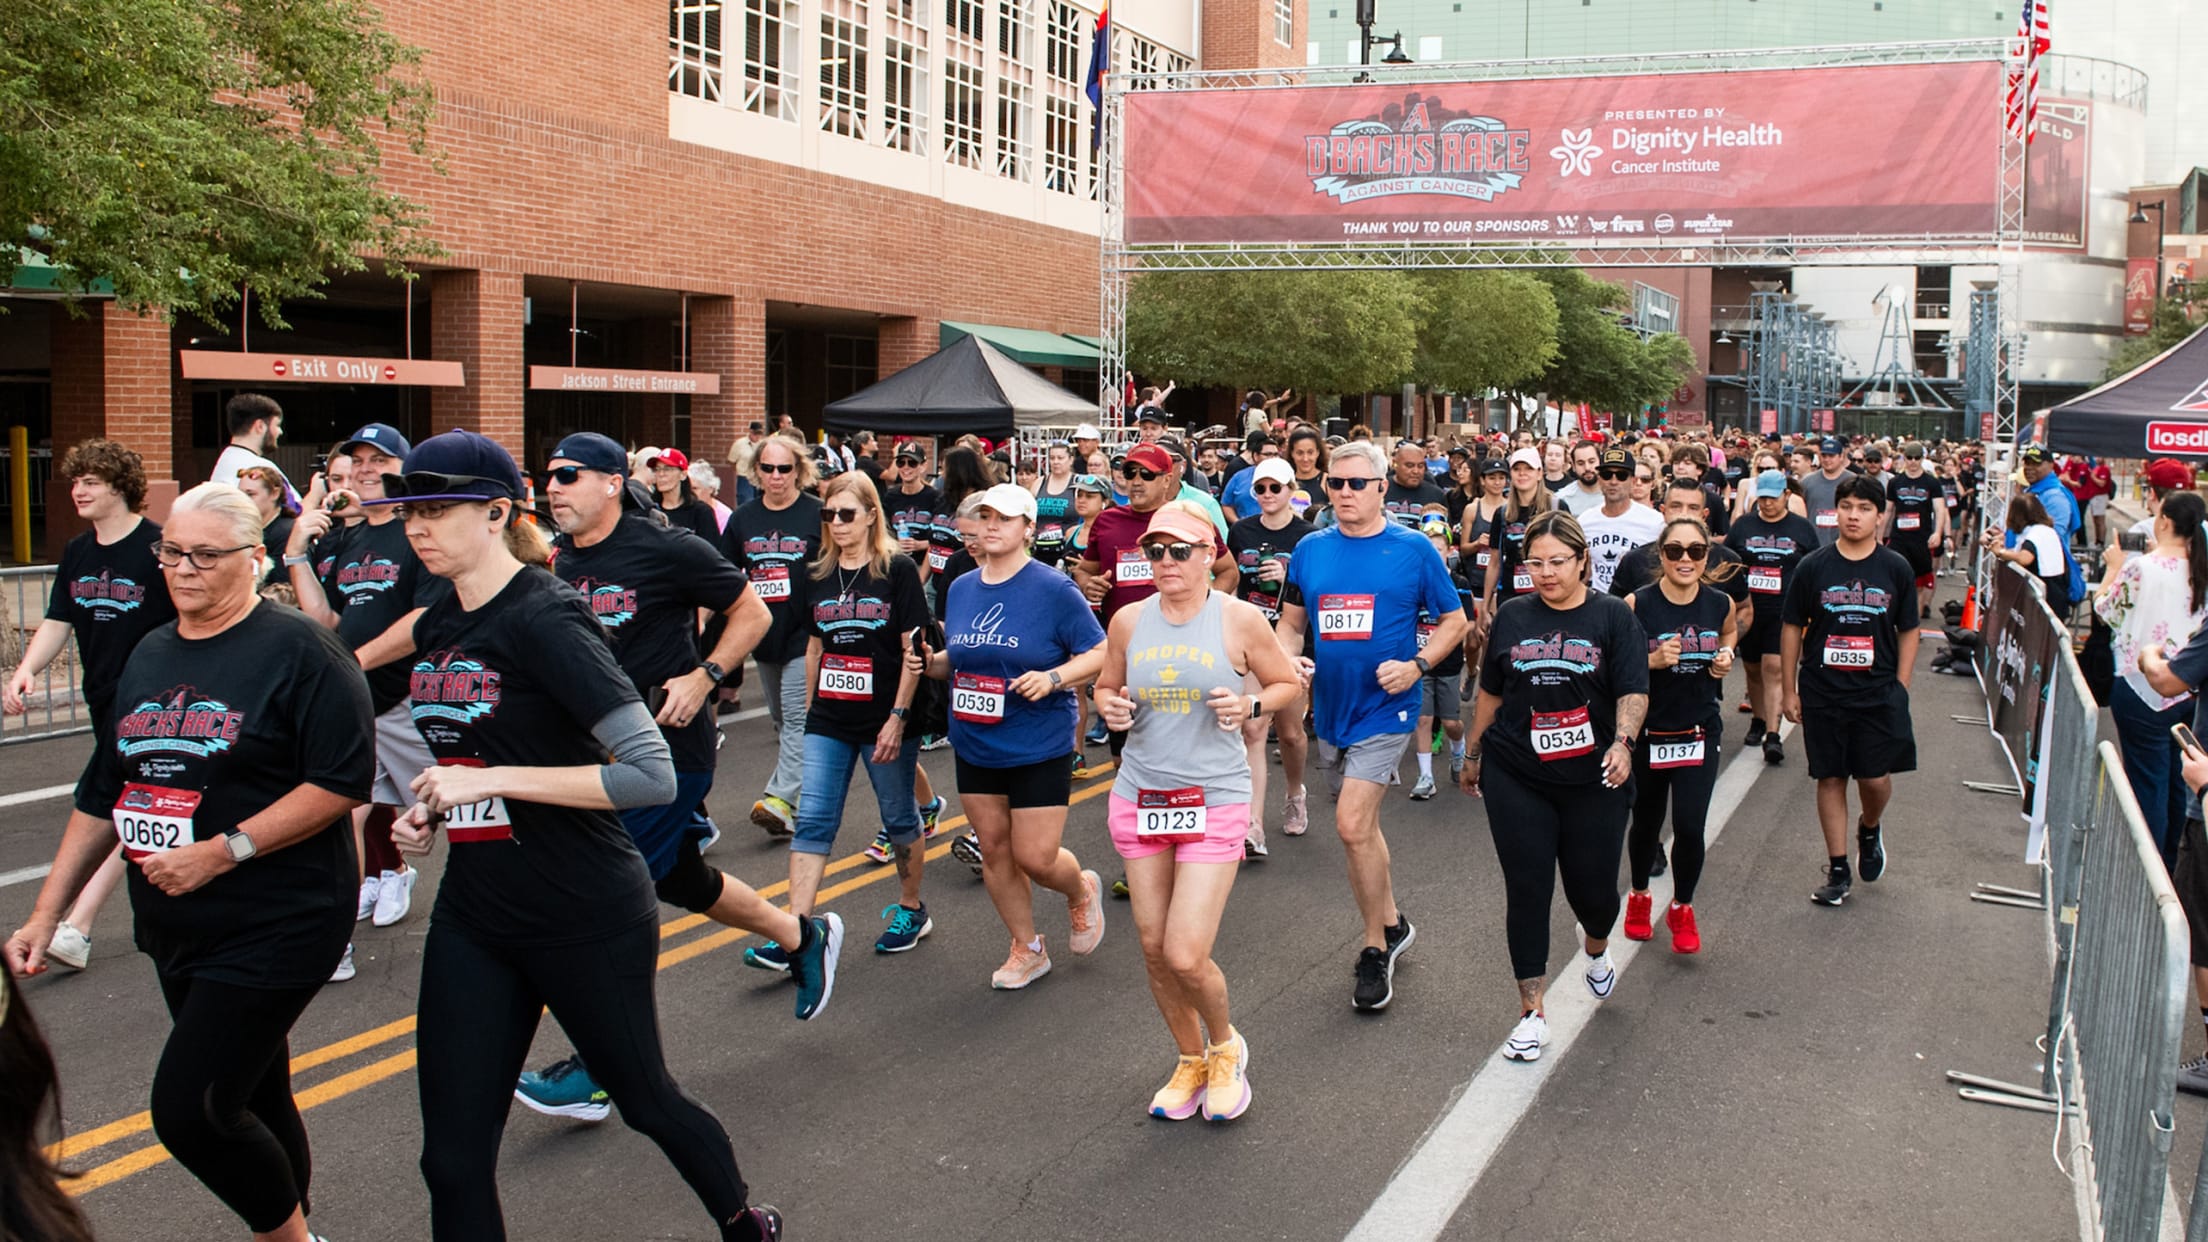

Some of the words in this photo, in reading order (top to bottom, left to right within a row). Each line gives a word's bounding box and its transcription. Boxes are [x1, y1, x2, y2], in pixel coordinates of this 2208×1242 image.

[1605, 109, 1698, 121] PRESENTED
[1704, 108, 1725, 118] BY
[1612, 126, 1698, 155] Dignity
[1702, 123, 1782, 147] Health
[1441, 130, 1529, 172] RACE
[1611, 159, 1658, 174] Cancer
[1662, 158, 1720, 173] Institute
[1347, 179, 1415, 199] AGAINST
[1421, 179, 1488, 197] CANCER
[1343, 222, 1388, 234] THANK
[1392, 221, 1419, 233] YOU
[1423, 221, 1440, 233] TO
[1443, 221, 1472, 233] OUR
[1475, 220, 1549, 232] SPONSORS
[2022, 231, 2078, 242] BASEBALL
[292, 359, 328, 377] Exit
[337, 361, 378, 383] Only
[562, 373, 607, 389] Jackson
[612, 374, 646, 390] Street
[651, 376, 697, 391] Entrance
[754, 582, 784, 595] 0204
[1518, 576, 1531, 587] 03
[1751, 577, 1777, 588] 0770
[592, 590, 637, 613] RACE
[1325, 613, 1365, 629] 0817
[950, 633, 1019, 648] GIMBELS
[1133, 645, 1215, 670] PROPER
[1830, 651, 1867, 665] 0535
[442, 671, 501, 702] RACE
[826, 673, 865, 690] 0580
[1138, 687, 1201, 701] BOXING
[957, 693, 996, 713] 0539
[1151, 701, 1191, 715] CLUB
[181, 710, 246, 741] RACE
[1540, 728, 1586, 750] 0534
[1658, 745, 1696, 760] 0137
[1148, 811, 1197, 830] 0123
[123, 817, 181, 849] 0662
